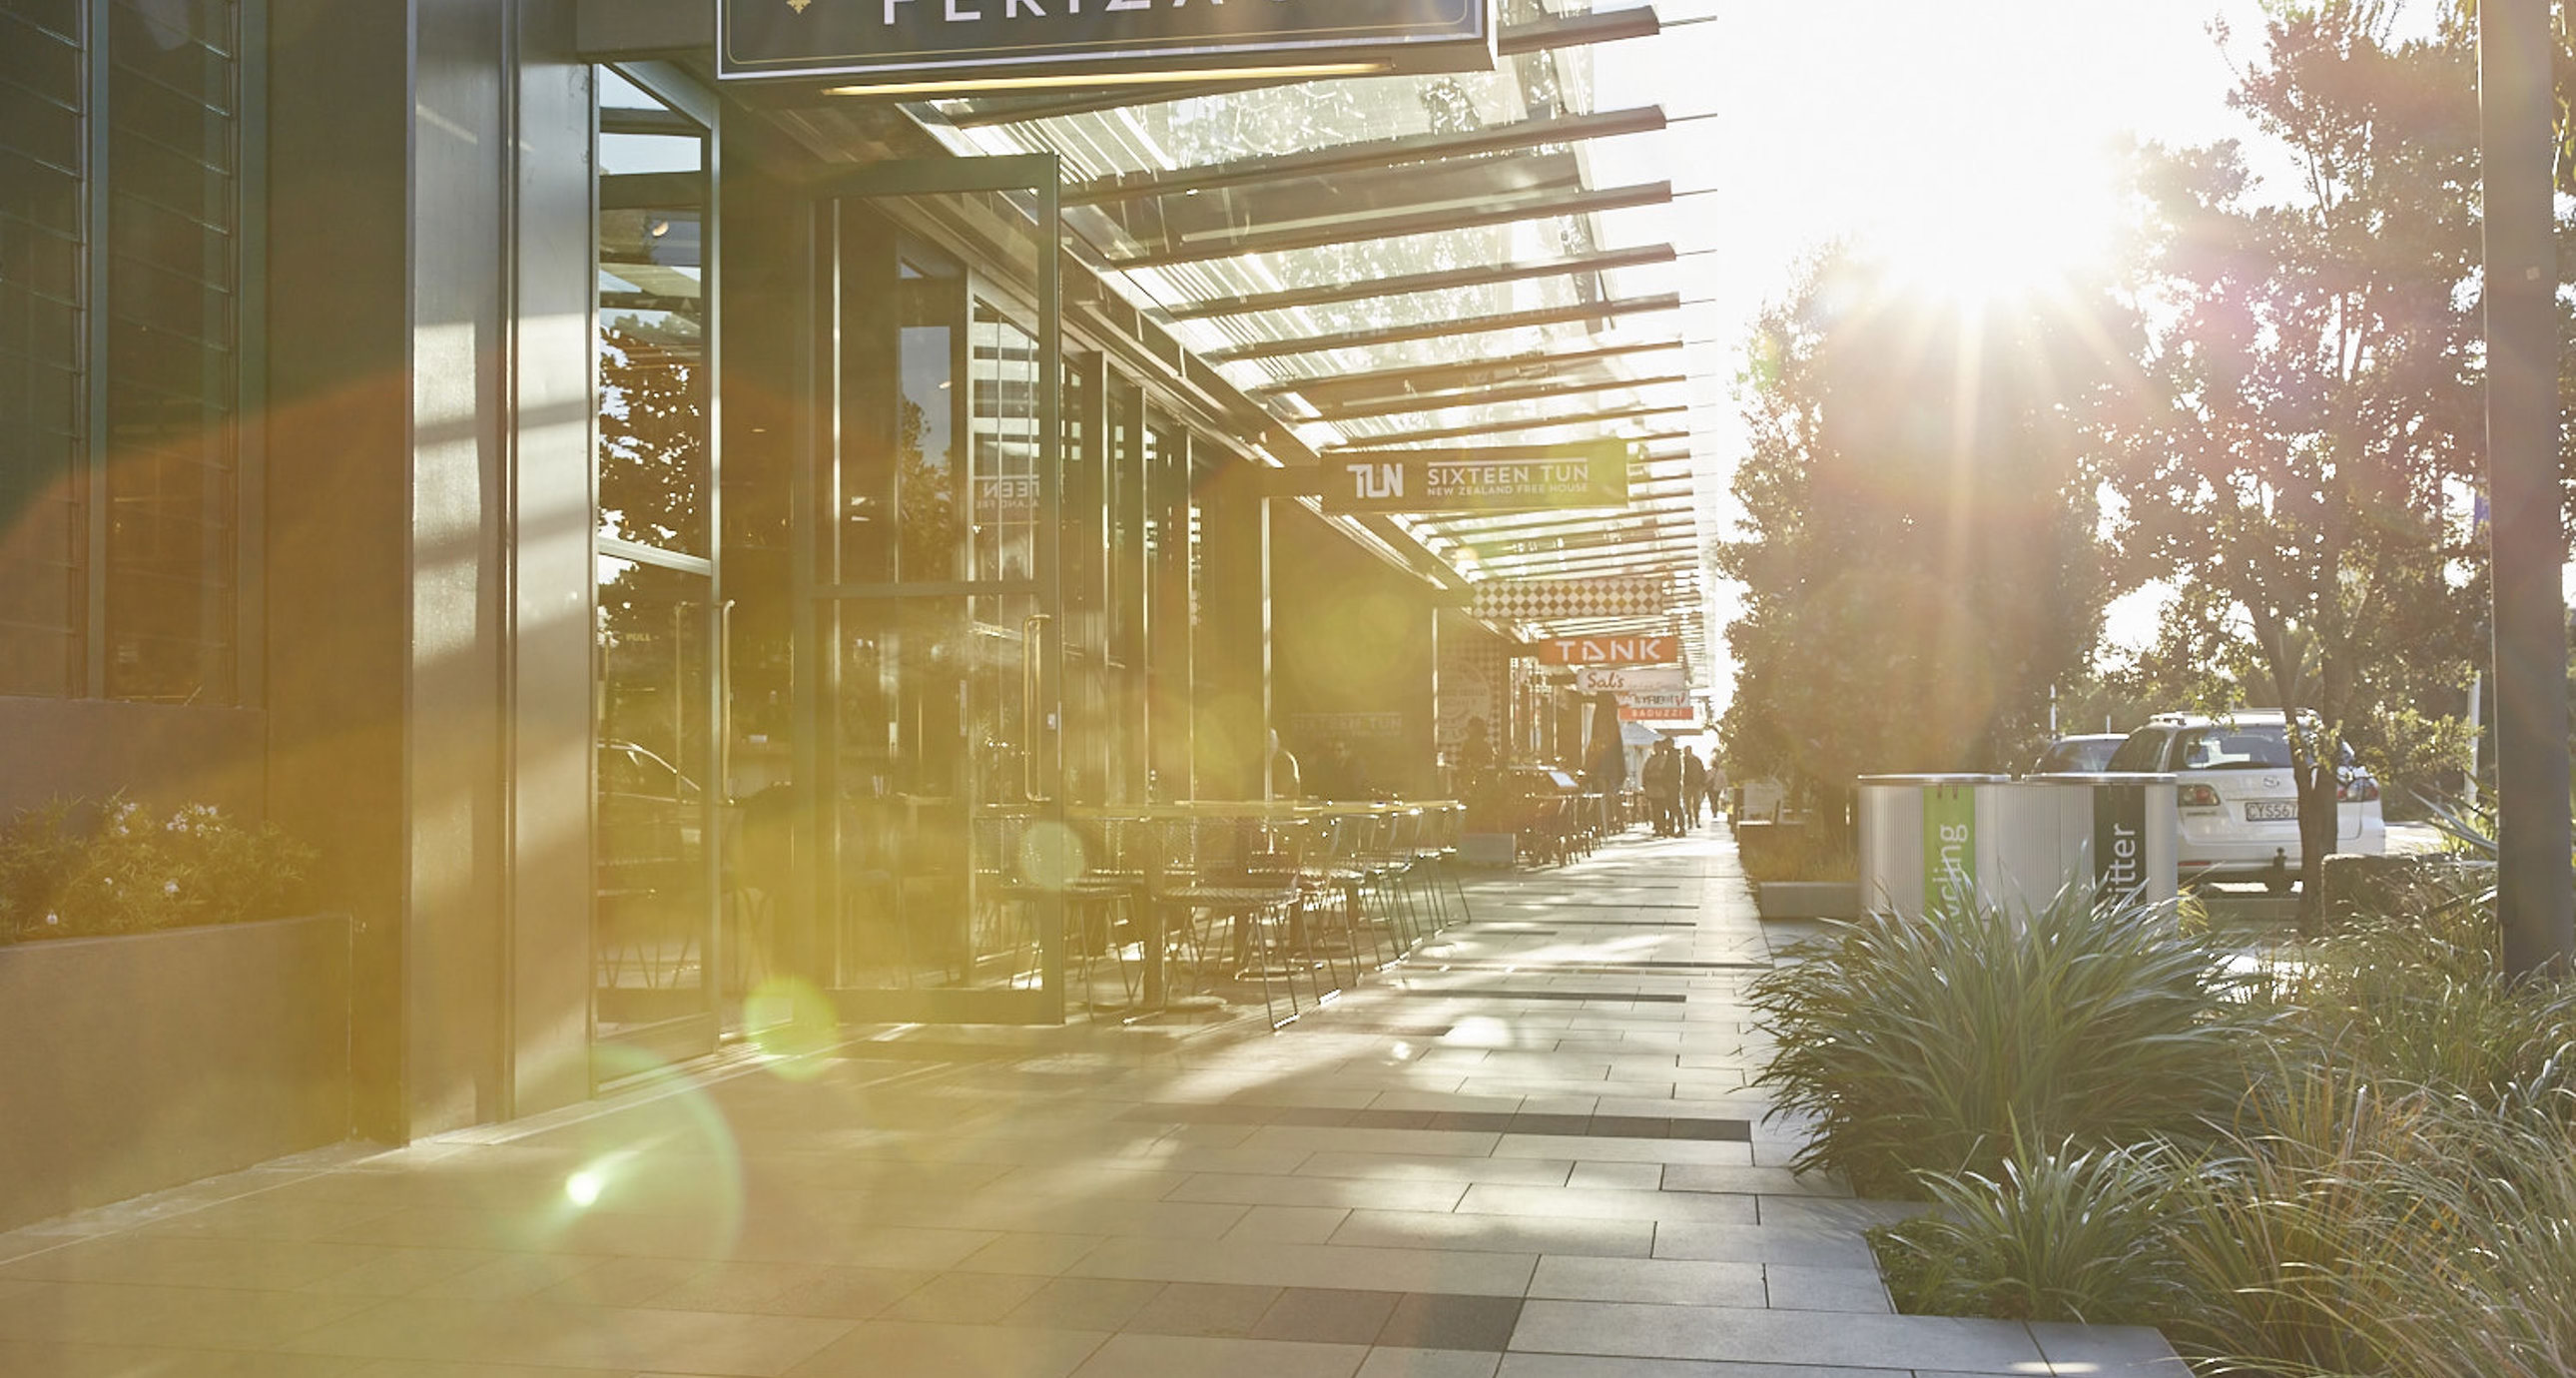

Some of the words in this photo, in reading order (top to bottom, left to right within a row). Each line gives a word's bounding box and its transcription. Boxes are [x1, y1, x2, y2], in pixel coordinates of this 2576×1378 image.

[1347, 462, 1404, 499] TUN
[1427, 466, 1529, 486] SIXTEEN
[1540, 463, 1589, 483] TUN
[1427, 486, 1454, 496] NEW
[1458, 485, 1514, 496] ZEALAND
[1517, 484, 1545, 494] FREE
[1549, 483, 1589, 493] HOUSE
[1555, 639, 1661, 662] TANK
[1587, 672, 1625, 689] Sal's
[2107, 822, 2136, 906] itter
